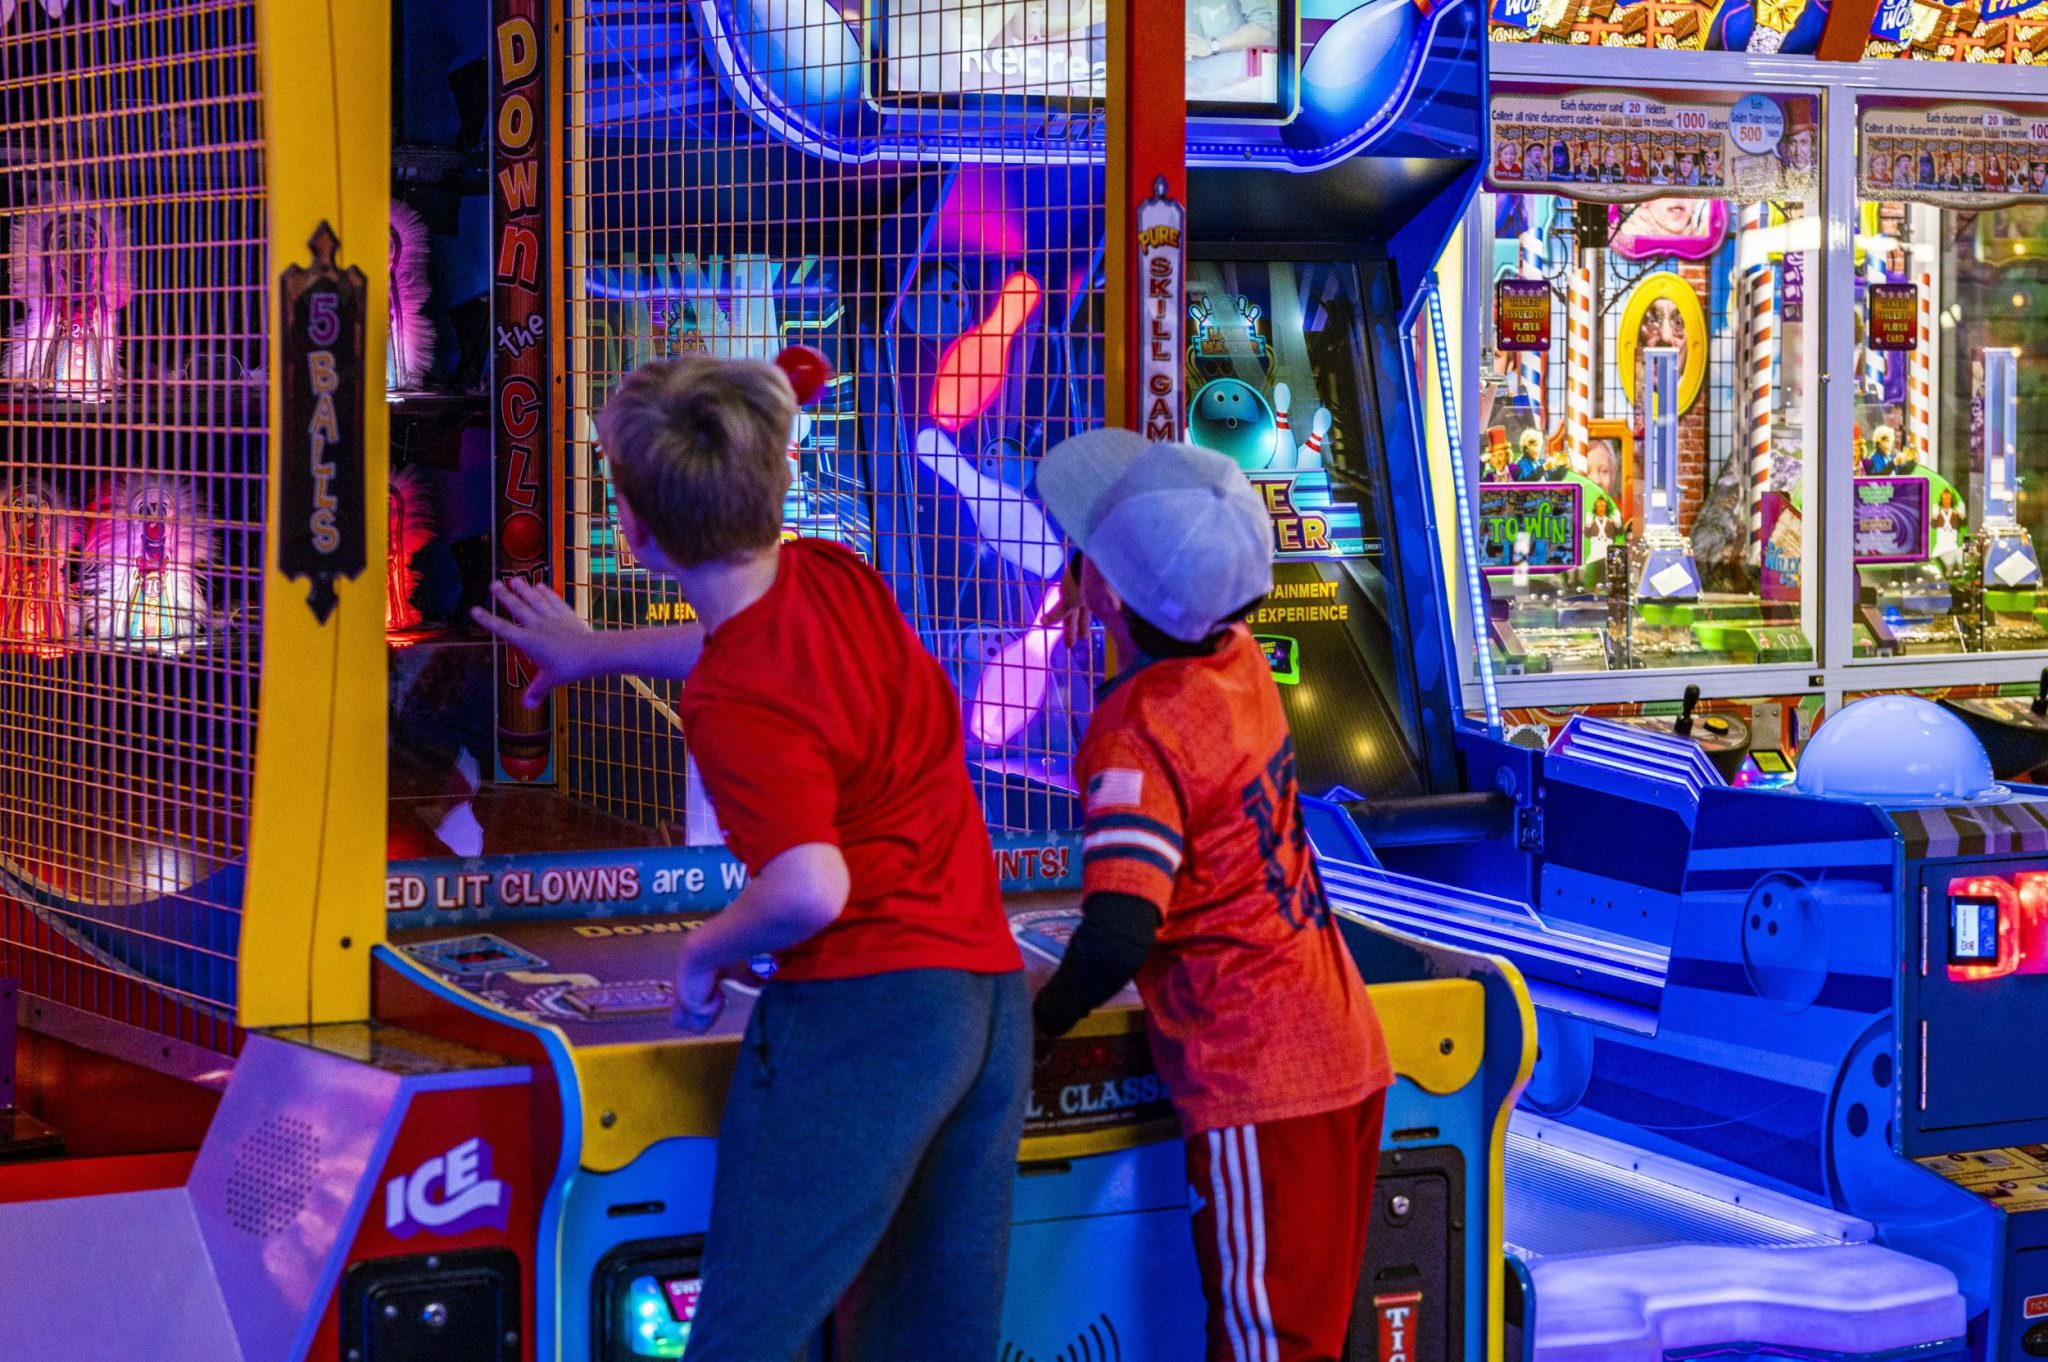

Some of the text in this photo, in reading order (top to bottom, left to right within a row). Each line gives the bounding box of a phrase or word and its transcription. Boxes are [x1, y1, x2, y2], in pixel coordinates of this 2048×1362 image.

[1492, 110, 1514, 121] Collect
[1515, 111, 1524, 122] all
[1525, 112, 1540, 123] nine
[1676, 112, 1706, 129] 1000
[1561, 100, 1577, 111] Each
[1578, 101, 1607, 112] character
[1609, 101, 1624, 112] card
[1629, 103, 1641, 114] 20
[1926, 113, 1941, 123] Each
[1988, 116, 1998, 126] 20
[1740, 126, 1762, 142] 500
[1138, 225, 1180, 256] PURE
[308, 292, 341, 346] 5
[1149, 257, 1173, 362] SKILL
[496, 314, 544, 357] the
[1512, 322, 1541, 332] PLAYER
[1516, 334, 1537, 343] CARD
[1886, 334, 1905, 343] CARD
[1146, 374, 1176, 443] GAM
[306, 350, 341, 555] BALLS
[1488, 516, 1520, 545] TO
[1258, 605, 1348, 624] EXPERIENCE
[435, 873, 491, 911] LIT
[500, 867, 641, 906] CLOWNS
[652, 867, 705, 894] are
[386, 1136, 503, 1230] ICE
